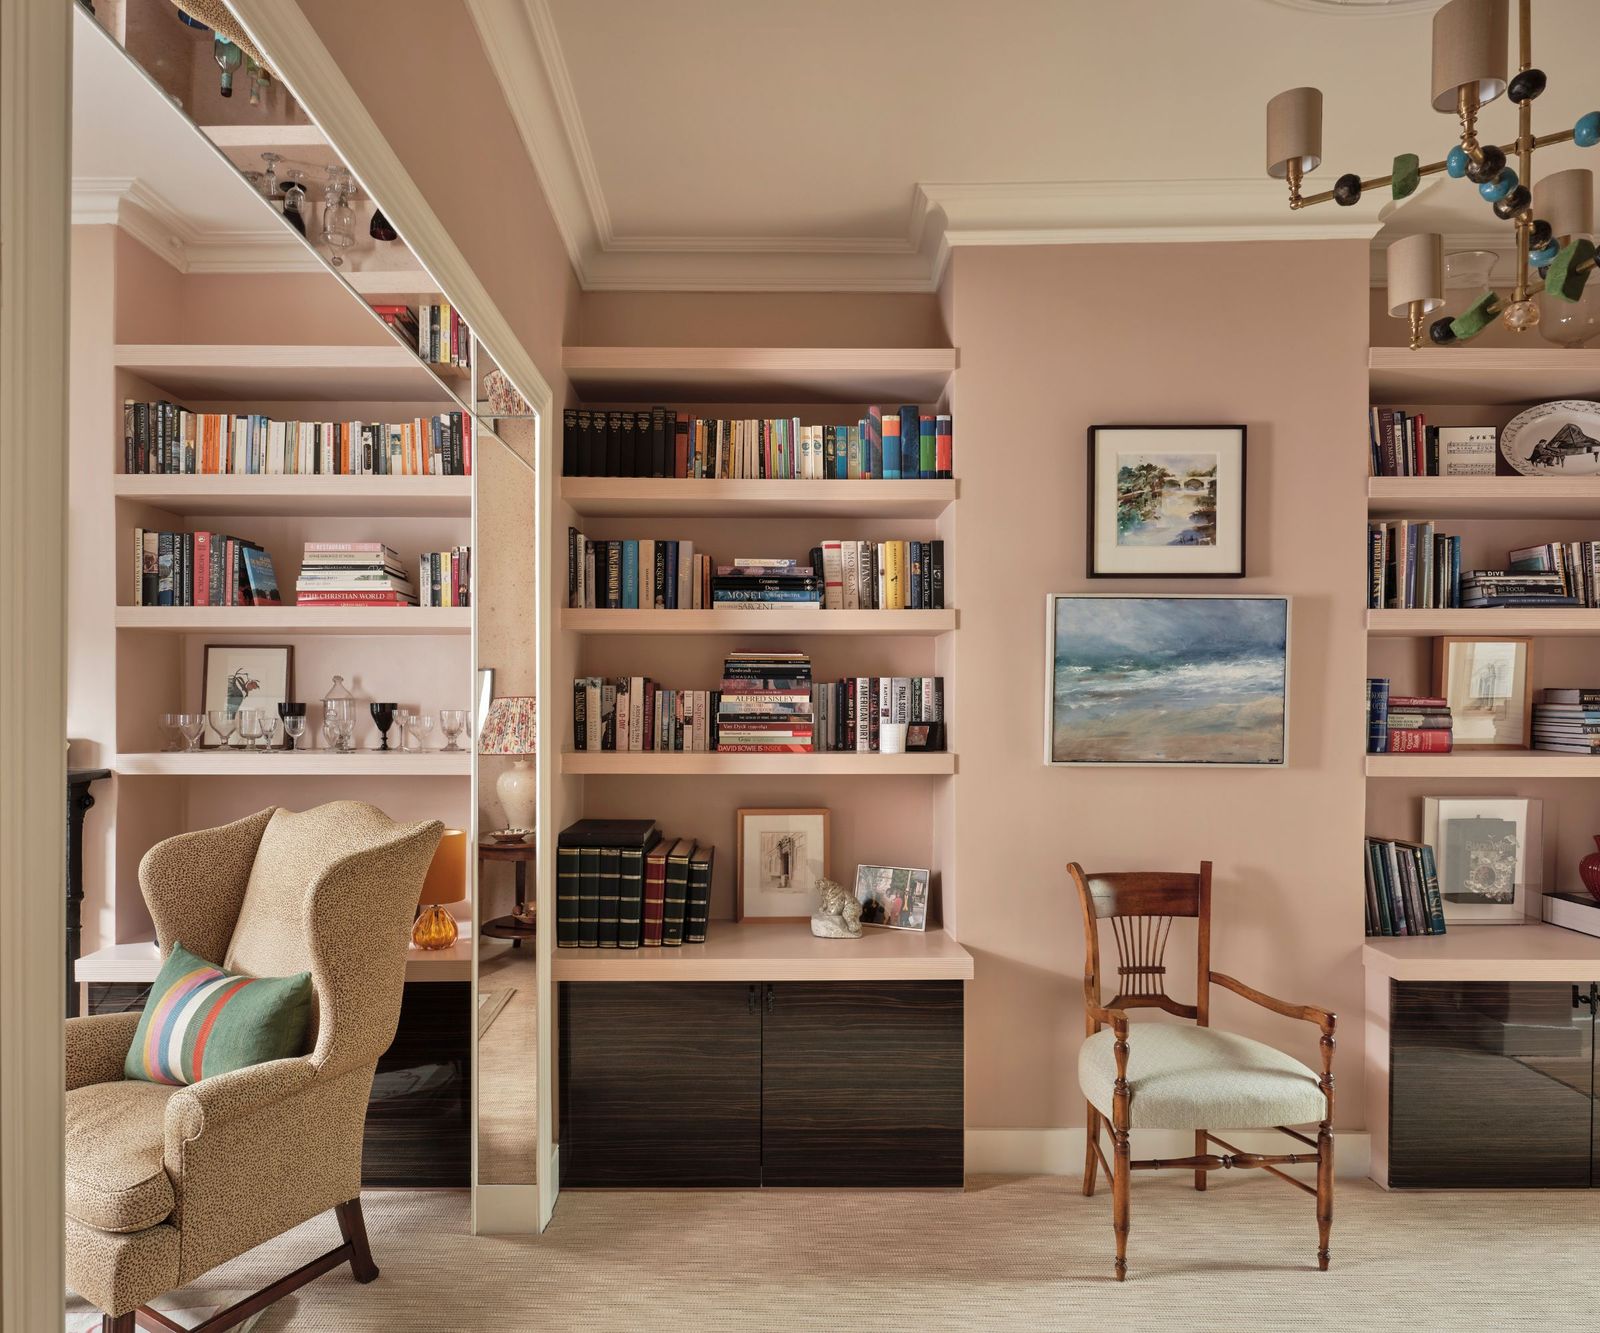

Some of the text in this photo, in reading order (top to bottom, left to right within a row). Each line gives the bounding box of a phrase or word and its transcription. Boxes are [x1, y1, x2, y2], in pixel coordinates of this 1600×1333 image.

[1386, 424, 1395, 468] INVESTMENTS
[609, 550, 619, 564] KING
[861, 550, 870, 583] TITAN
[609, 565, 619, 589] EDWARD
[847, 551, 856, 596] MORGAN
[320, 592, 359, 600] CHRISTIAN
[360, 592, 386, 600] WORLD
[727, 591, 762, 599] MONET
[576, 691, 585, 722] STALINGRAD
[695, 703, 703, 731] Sapiens
[860, 685, 868, 740] AMERICAN DIRT
[898, 686, 906, 724] FINAL SOLUTIO
[1425, 876, 1443, 921] MUSIC
